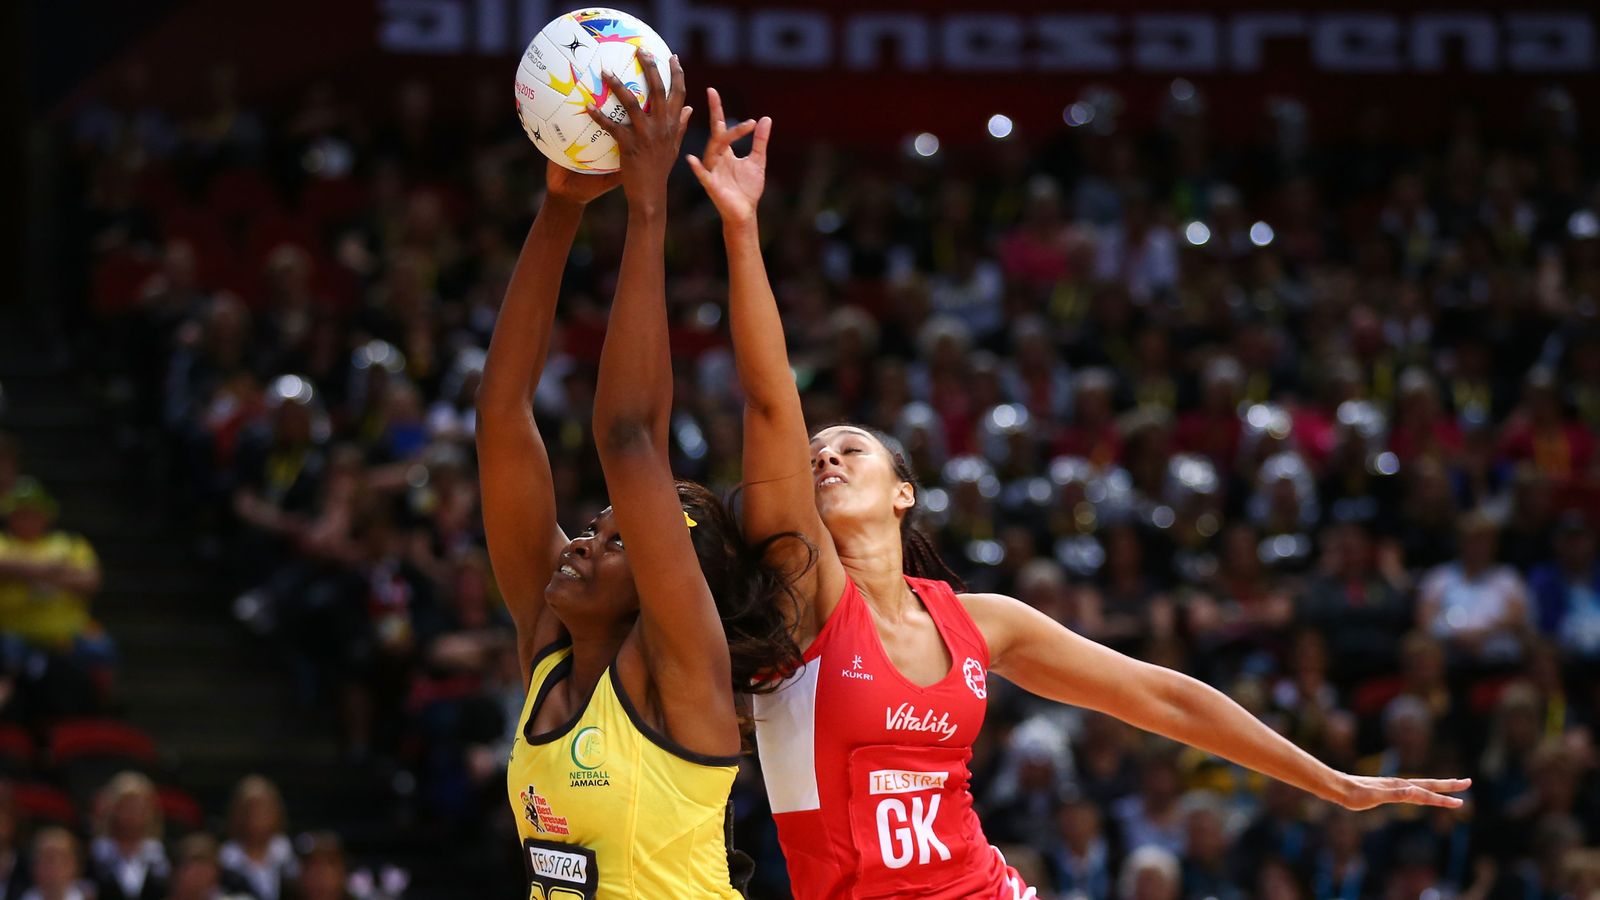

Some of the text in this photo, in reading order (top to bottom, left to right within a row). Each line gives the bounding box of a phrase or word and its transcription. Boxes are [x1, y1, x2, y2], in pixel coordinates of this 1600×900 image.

[378, 0, 1595, 71] allhonesarena
[536, 60, 547, 71] CUP
[590, 129, 602, 143] CUP
[842, 669, 873, 681] KUKRI
[886, 702, 957, 741] Vitality
[569, 771, 610, 779] NETBALL
[570, 779, 610, 787] JAMAICA
[874, 773, 943, 791] TELSTRA
[876, 794, 951, 869] GK
[532, 852, 583, 879] TELSTRA
